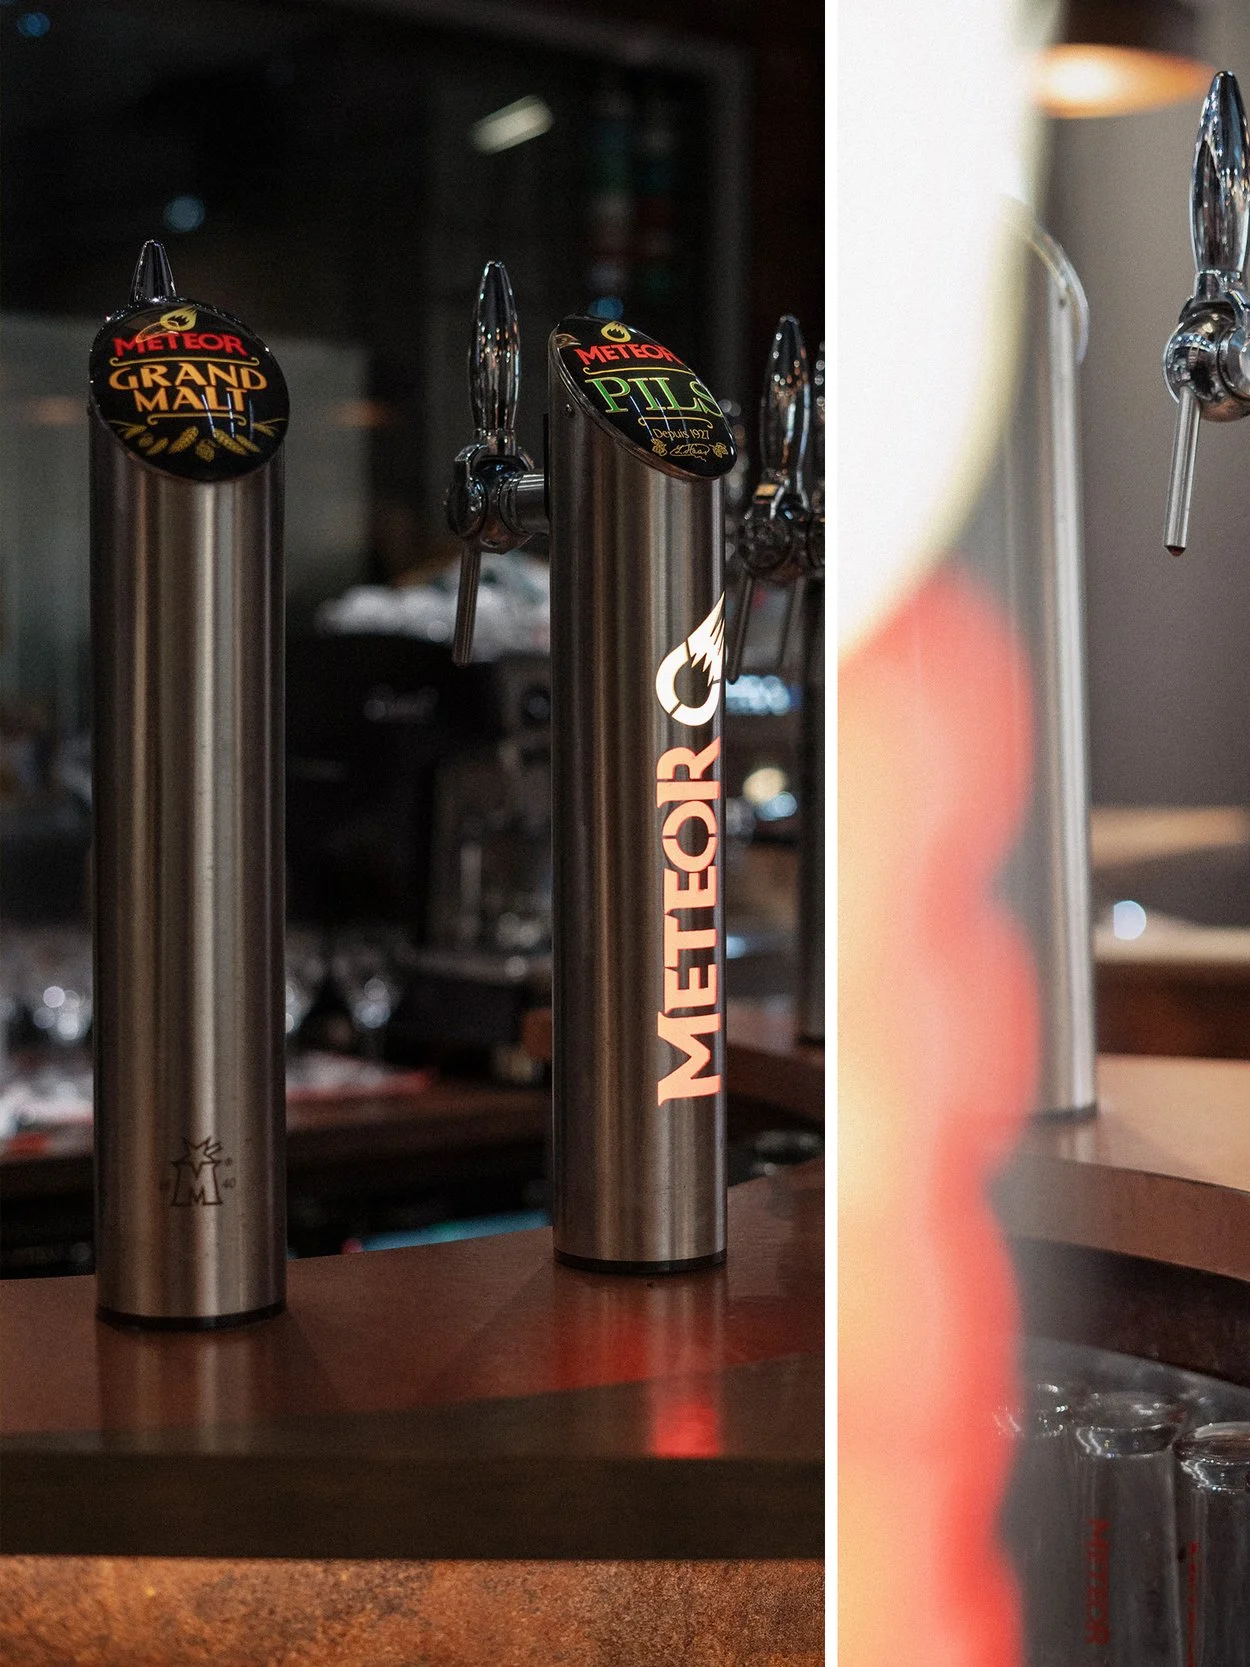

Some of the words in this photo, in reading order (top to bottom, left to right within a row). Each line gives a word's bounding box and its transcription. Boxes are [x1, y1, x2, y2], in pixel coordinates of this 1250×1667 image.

[111, 331, 248, 357] METEOR
[108, 362, 268, 390] GRAND
[133, 386, 247, 412] MALT
[584, 376, 724, 418] PILS
[652, 428, 689, 442] Depuis
[690, 428, 710, 440] 1927
[656, 736, 721, 1107] METEOR
